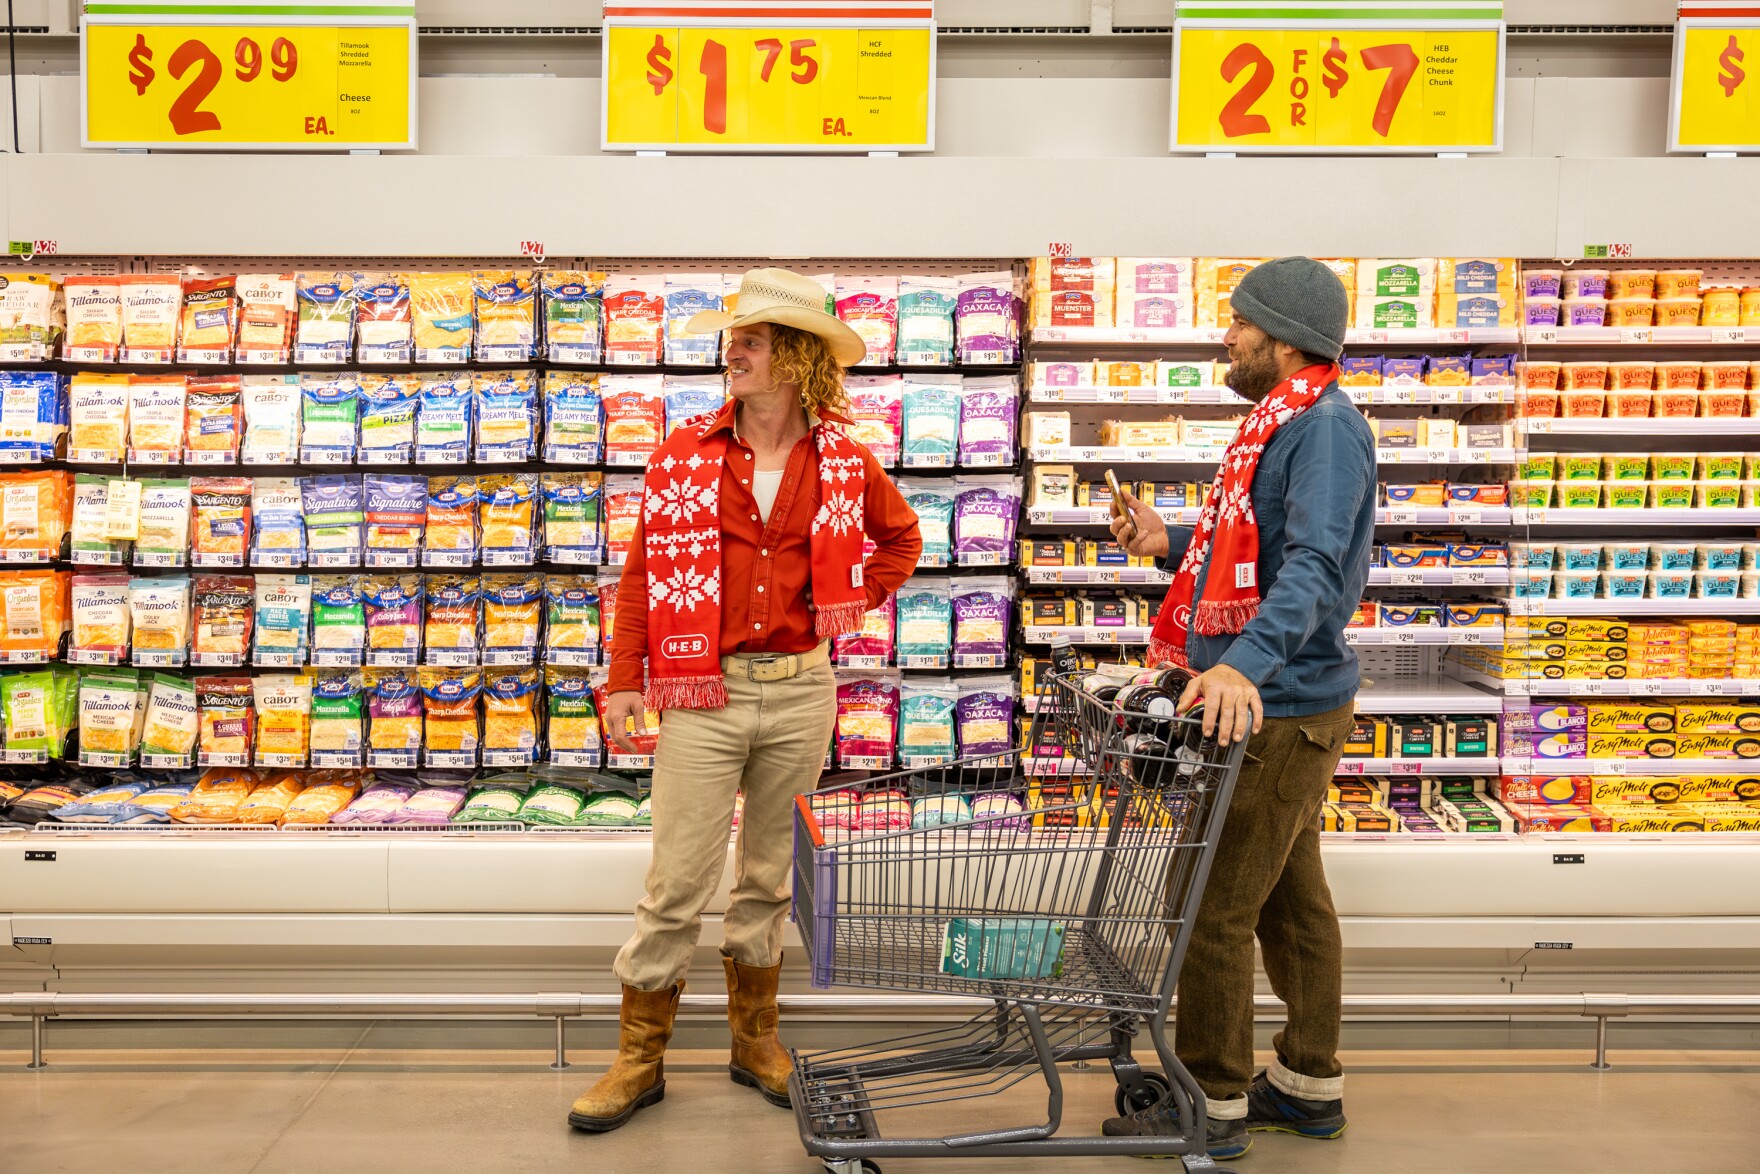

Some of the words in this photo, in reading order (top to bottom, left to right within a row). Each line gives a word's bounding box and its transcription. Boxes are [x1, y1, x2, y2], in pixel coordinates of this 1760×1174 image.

[860, 50, 892, 58] Shredded
[1433, 44, 1450, 52] HEB
[1425, 55, 1458, 64] Cheddar
[1426, 67, 1455, 75] Cheese
[1428, 78, 1454, 86] Chunk
[1218, 42, 1275, 138] 2
[339, 93, 371, 102] Cheese
[304, 116, 335, 135] EA.
[822, 117, 853, 137] EA.
[34, 241, 57, 254] A26
[521, 241, 544, 255] A27
[1050, 243, 1072, 257] A28
[1609, 244, 1631, 257] A29
[71, 295, 122, 307] Tillamook
[962, 303, 1002, 313] OAXACA
[964, 408, 1004, 417] OAXACA
[305, 497, 358, 513] Signature
[368, 497, 423, 513] Signature
[963, 505, 1003, 514] OAXACA
[374, 514, 398, 522] CHEDDAR
[76, 595, 128, 609] Tillamook
[133, 599, 179, 611] Tillamook
[323, 612, 355, 620] Mozzarella
[959, 608, 1000, 618] OAXACA
[83, 698, 132, 712] Tillamook
[201, 694, 245, 707] SARGENTO
[559, 700, 585, 708] Mexican
[316, 705, 349, 713] Mozzarella
[965, 708, 1004, 719] OAXACA
[1560, 716, 1586, 727] BLANCO
[1590, 713, 1617, 727] Easy
[1615, 709, 1644, 722] Melt
[1679, 713, 1706, 728] Easy
[1703, 709, 1734, 723] Melt
[1595, 785, 1623, 799] Easy
[1620, 781, 1650, 795] Melt
[1679, 783, 1705, 797] Easy
[1703, 779, 1733, 793] Melt
[953, 932, 969, 969] Silk
